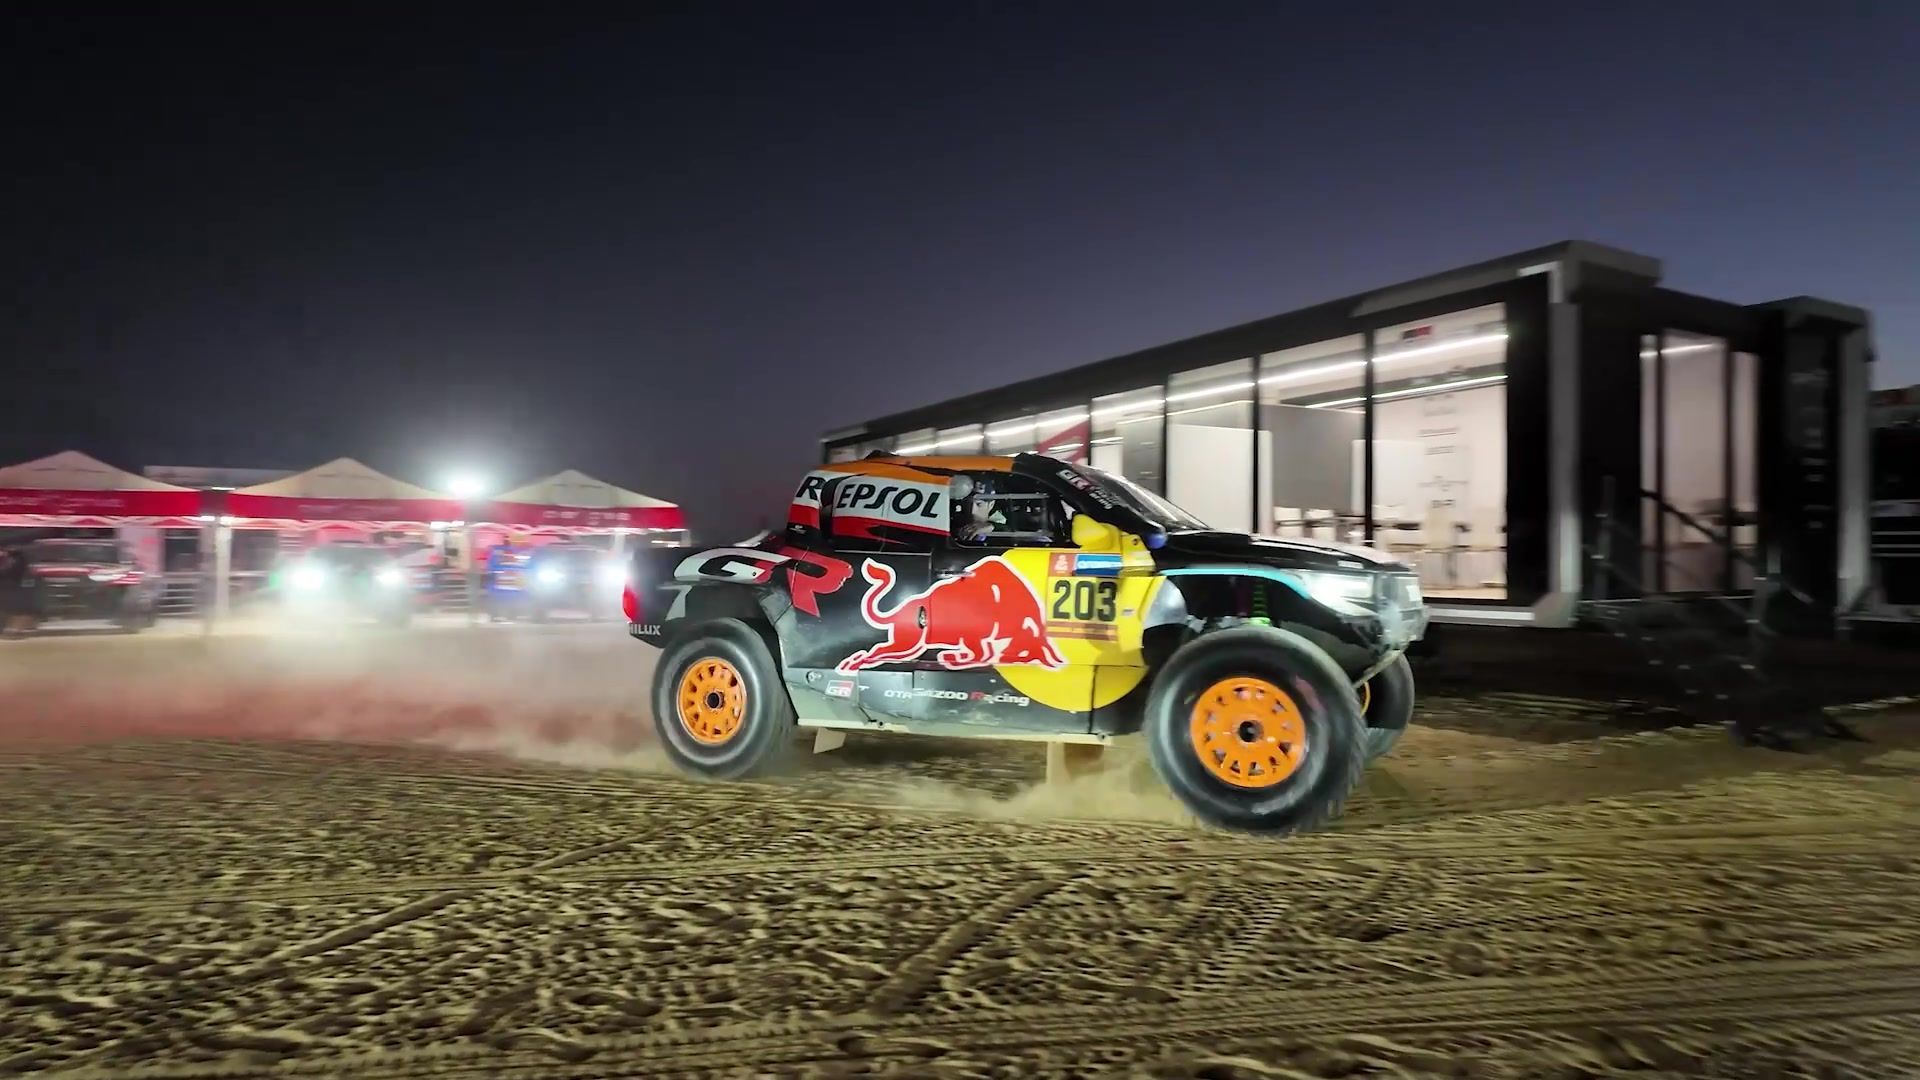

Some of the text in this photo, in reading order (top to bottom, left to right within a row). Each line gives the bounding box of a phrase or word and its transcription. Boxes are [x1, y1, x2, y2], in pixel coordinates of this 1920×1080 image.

[796, 475, 941, 519] REPSOL
[674, 548, 855, 618] GR
[1053, 580, 1117, 622] 203
